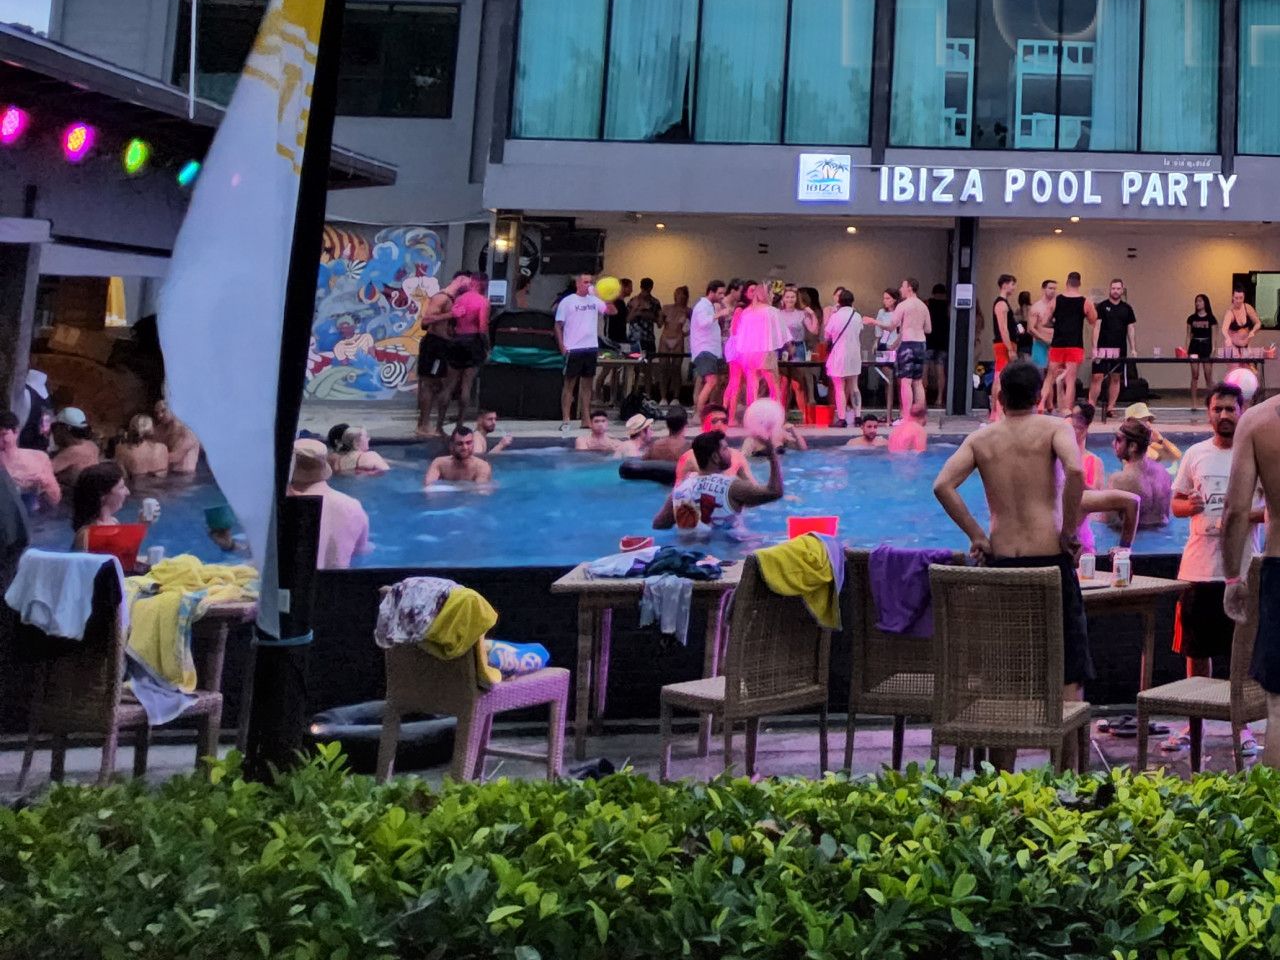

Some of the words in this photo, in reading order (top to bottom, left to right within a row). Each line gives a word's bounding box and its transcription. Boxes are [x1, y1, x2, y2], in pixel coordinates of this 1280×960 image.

[806, 184, 843, 193] IBIZA
[879, 166, 983, 203] IBIZA
[1005, 168, 1101, 204] POOL
[1123, 171, 1237, 208] PARTY
